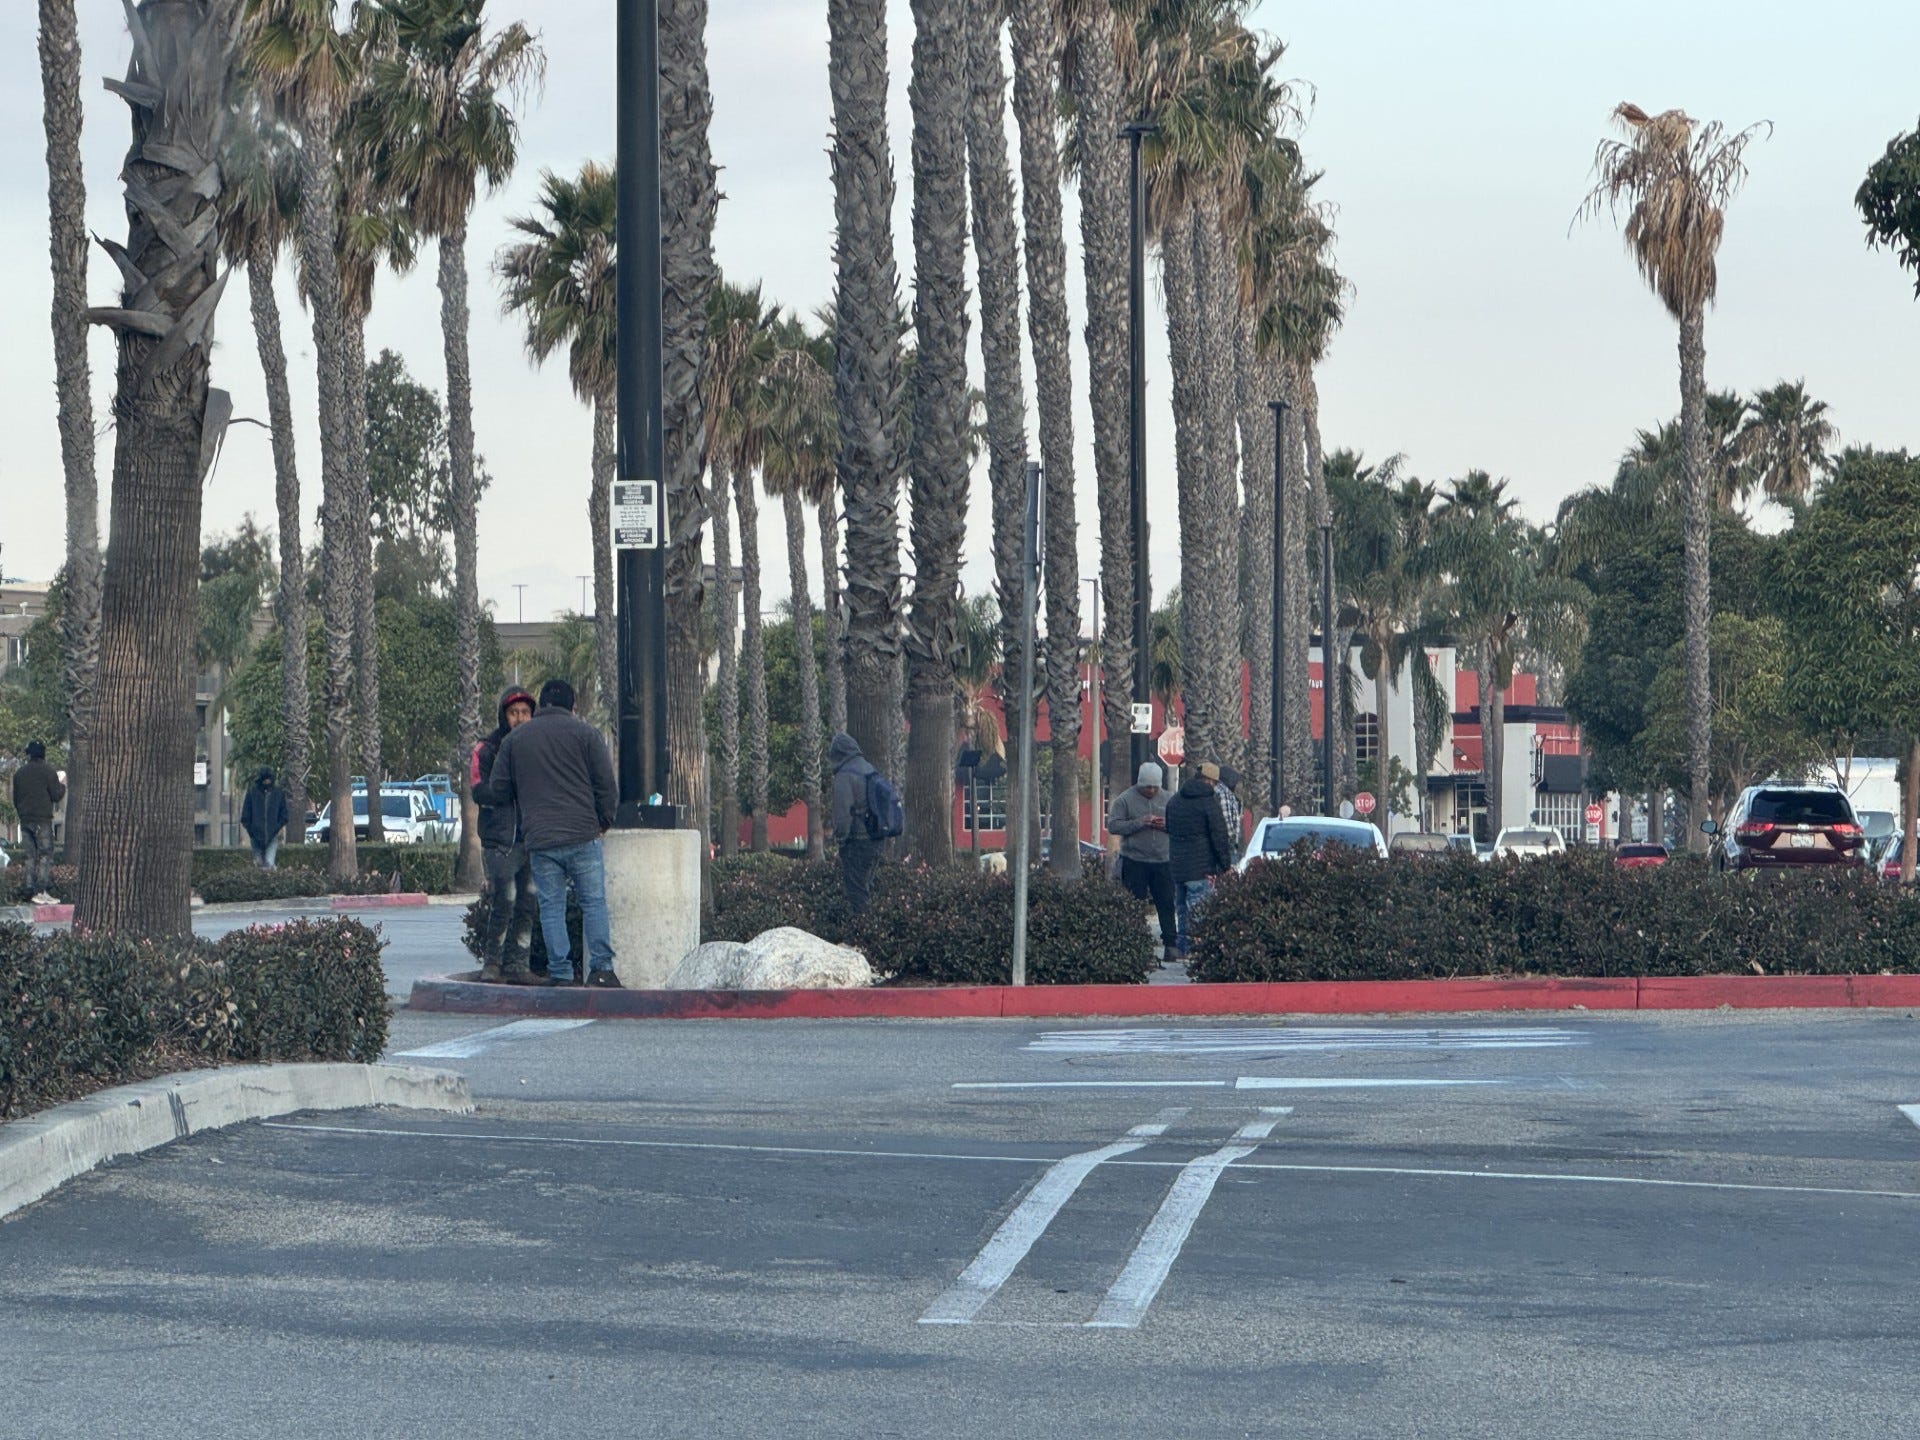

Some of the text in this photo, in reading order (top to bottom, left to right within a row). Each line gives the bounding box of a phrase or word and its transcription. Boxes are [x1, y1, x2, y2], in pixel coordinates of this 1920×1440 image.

[1160, 738, 1184, 755] STO
[1356, 799, 1375, 808] STOP
[1586, 810, 1602, 819] STOP
